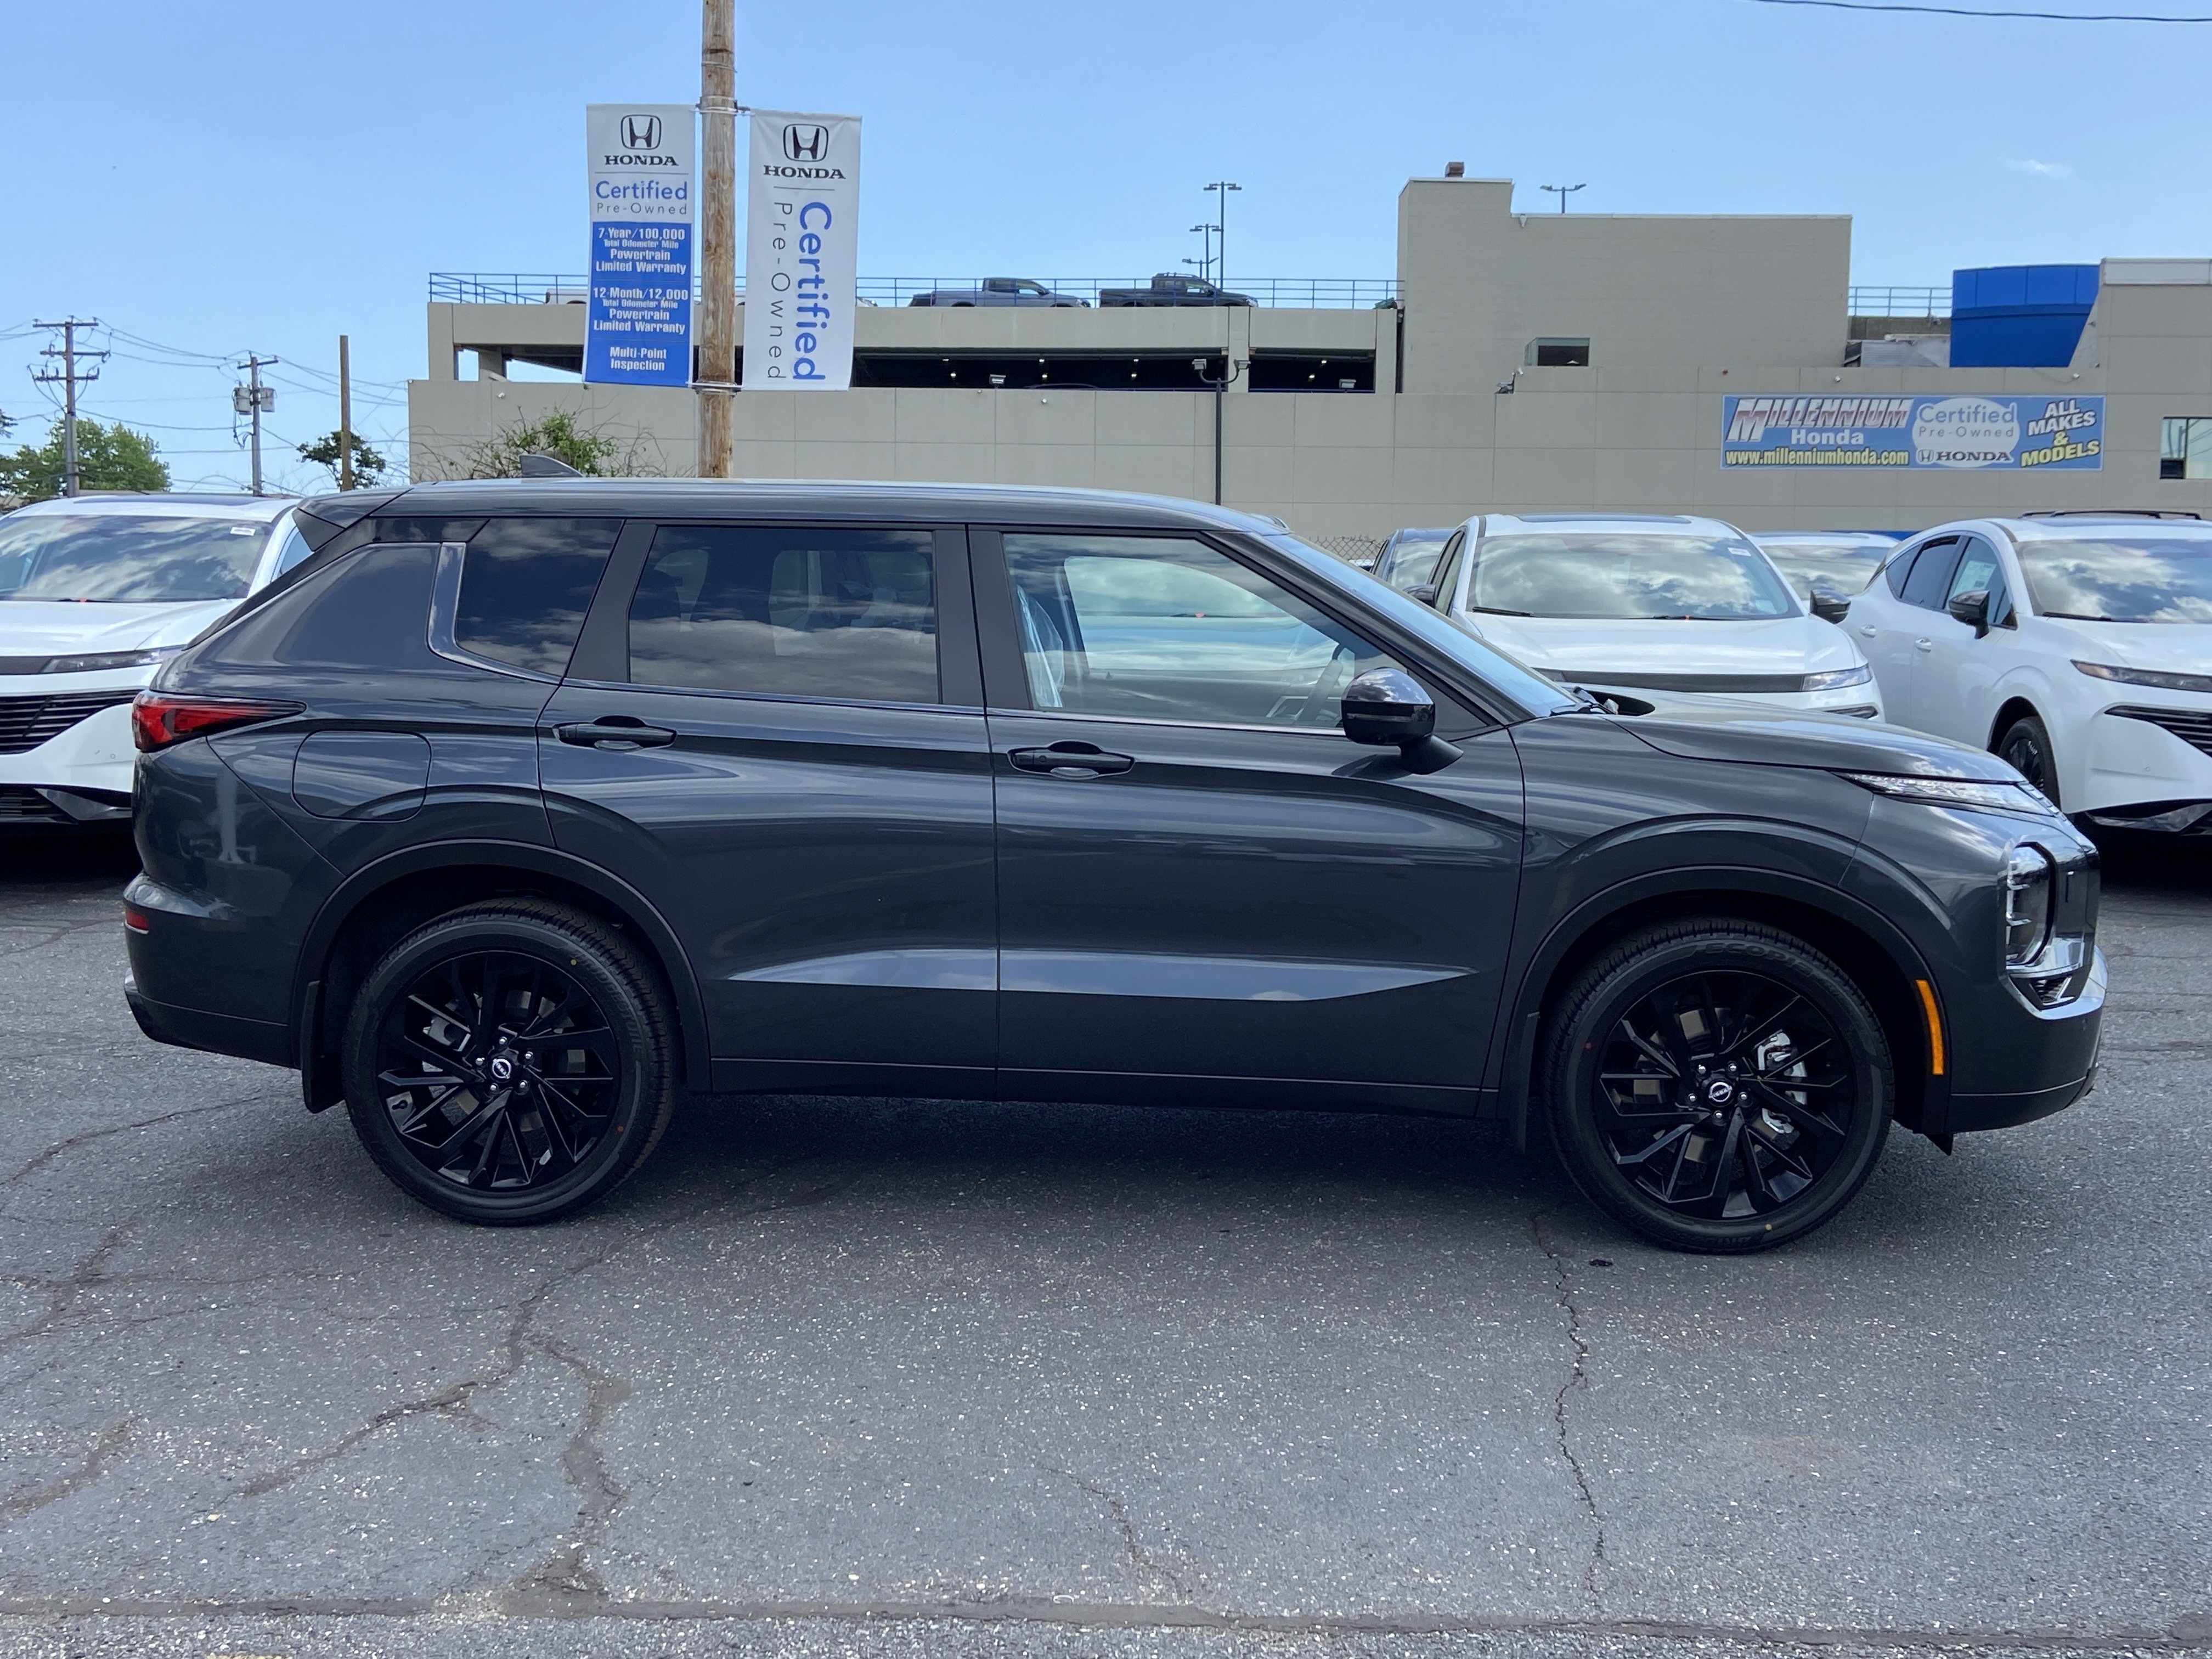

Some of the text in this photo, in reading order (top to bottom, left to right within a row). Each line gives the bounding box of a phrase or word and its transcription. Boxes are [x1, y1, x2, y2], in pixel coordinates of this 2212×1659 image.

[605, 155, 679, 166] HONDA
[763, 165, 846, 179] HONDA
[596, 180, 687, 200] Certified
[597, 202, 687, 215] Pre-Owned
[622, 239, 658, 248] Odometer
[661, 241, 679, 249] Mile
[611, 249, 670, 261] Powertrain
[596, 261, 686, 275] Limited Warranty
[768, 202, 793, 378] Pre-Owned
[793, 202, 832, 380] Certified
[622, 299, 658, 308] Odometer
[661, 300, 678, 309] Mile
[610, 308, 669, 320] Powertrain
[594, 320, 685, 335] Limited Warranty
[610, 347, 667, 359] Multi-Point
[611, 359, 665, 371] Inspection
[1919, 405, 2016, 424] Certified
[2045, 399, 2080, 418] ALL
[1725, 398, 1914, 442] MILLENNIUM
[2028, 411, 2096, 436] MAKES
[1791, 429, 1864, 444] Honda
[1919, 426, 2014, 437] Pre-Owned
[2053, 431, 2069, 445] &
[1725, 447, 1910, 465] www.millenniumhonda.com
[1936, 452, 2011, 461] HONDA
[2021, 440, 2100, 467] MODELS
[1704, 943, 1814, 979] ECOPIA
